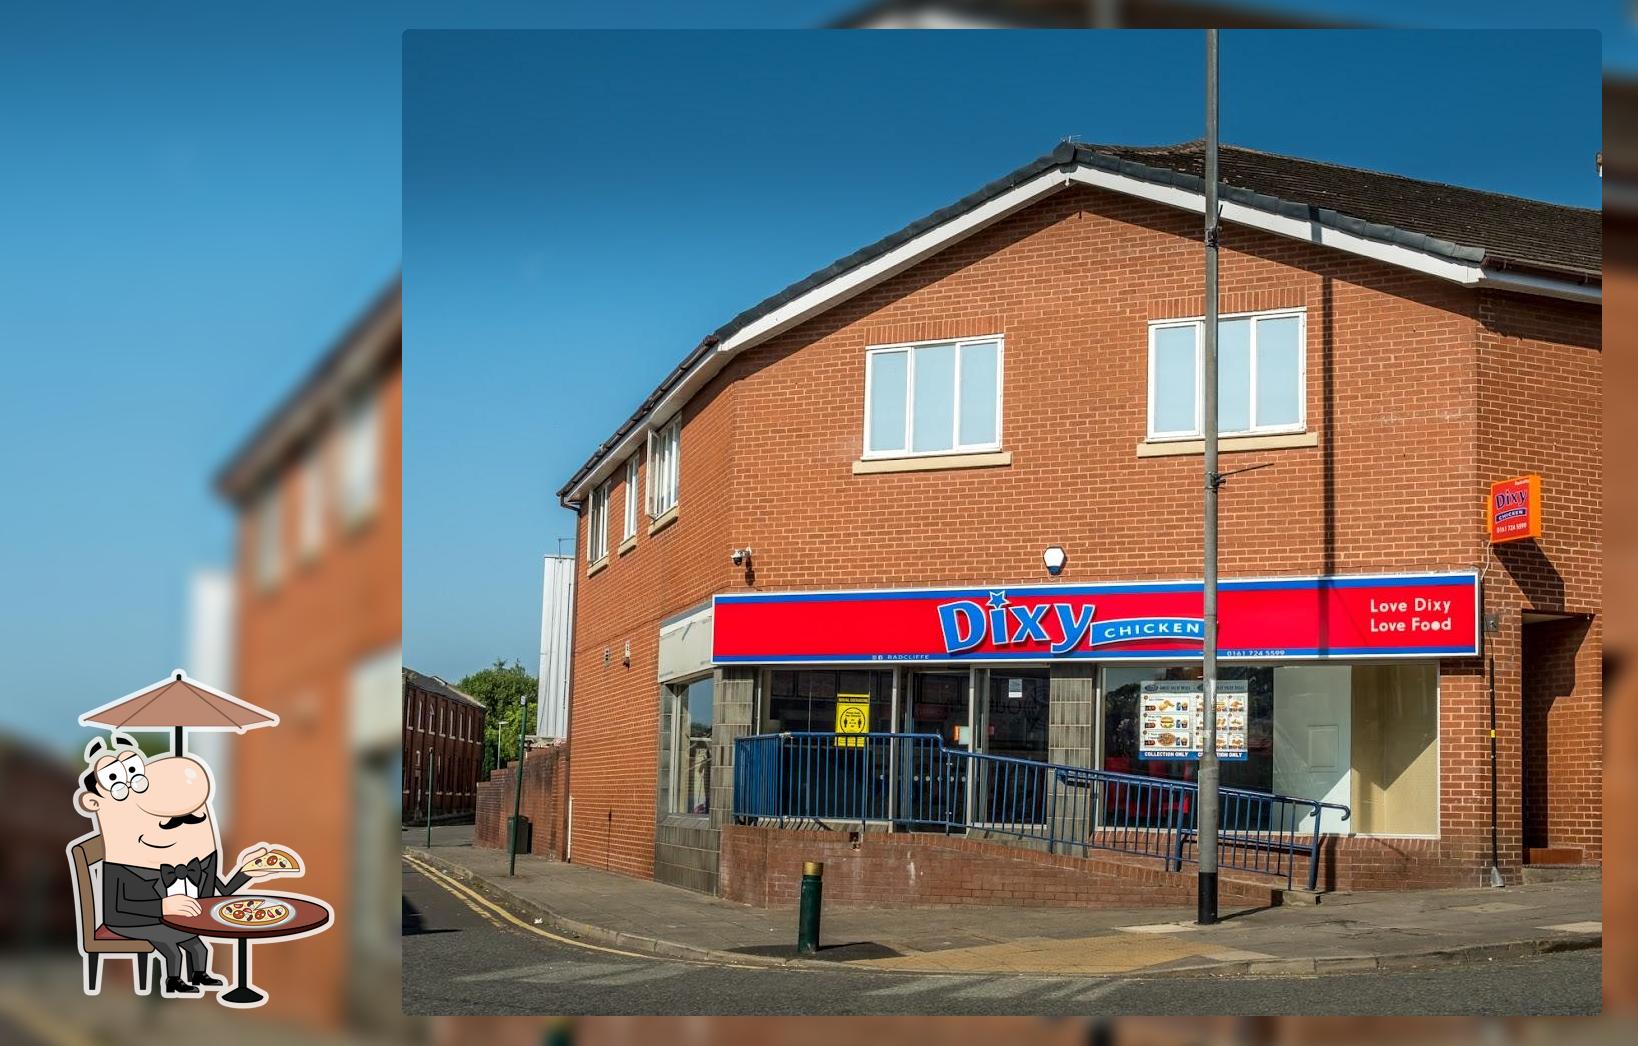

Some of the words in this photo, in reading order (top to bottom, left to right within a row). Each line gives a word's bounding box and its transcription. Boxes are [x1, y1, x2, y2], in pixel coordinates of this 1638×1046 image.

[1494, 488, 1528, 510] Dixy
[1498, 510, 1524, 521] CHICKEN
[1370, 598, 1408, 613] Love
[1414, 597, 1451, 614] Dixy
[938, 590, 1095, 653] Dixy
[1104, 622, 1200, 638] CHICKEN
[1370, 617, 1406, 632] Love
[1411, 616, 1452, 631] Food
